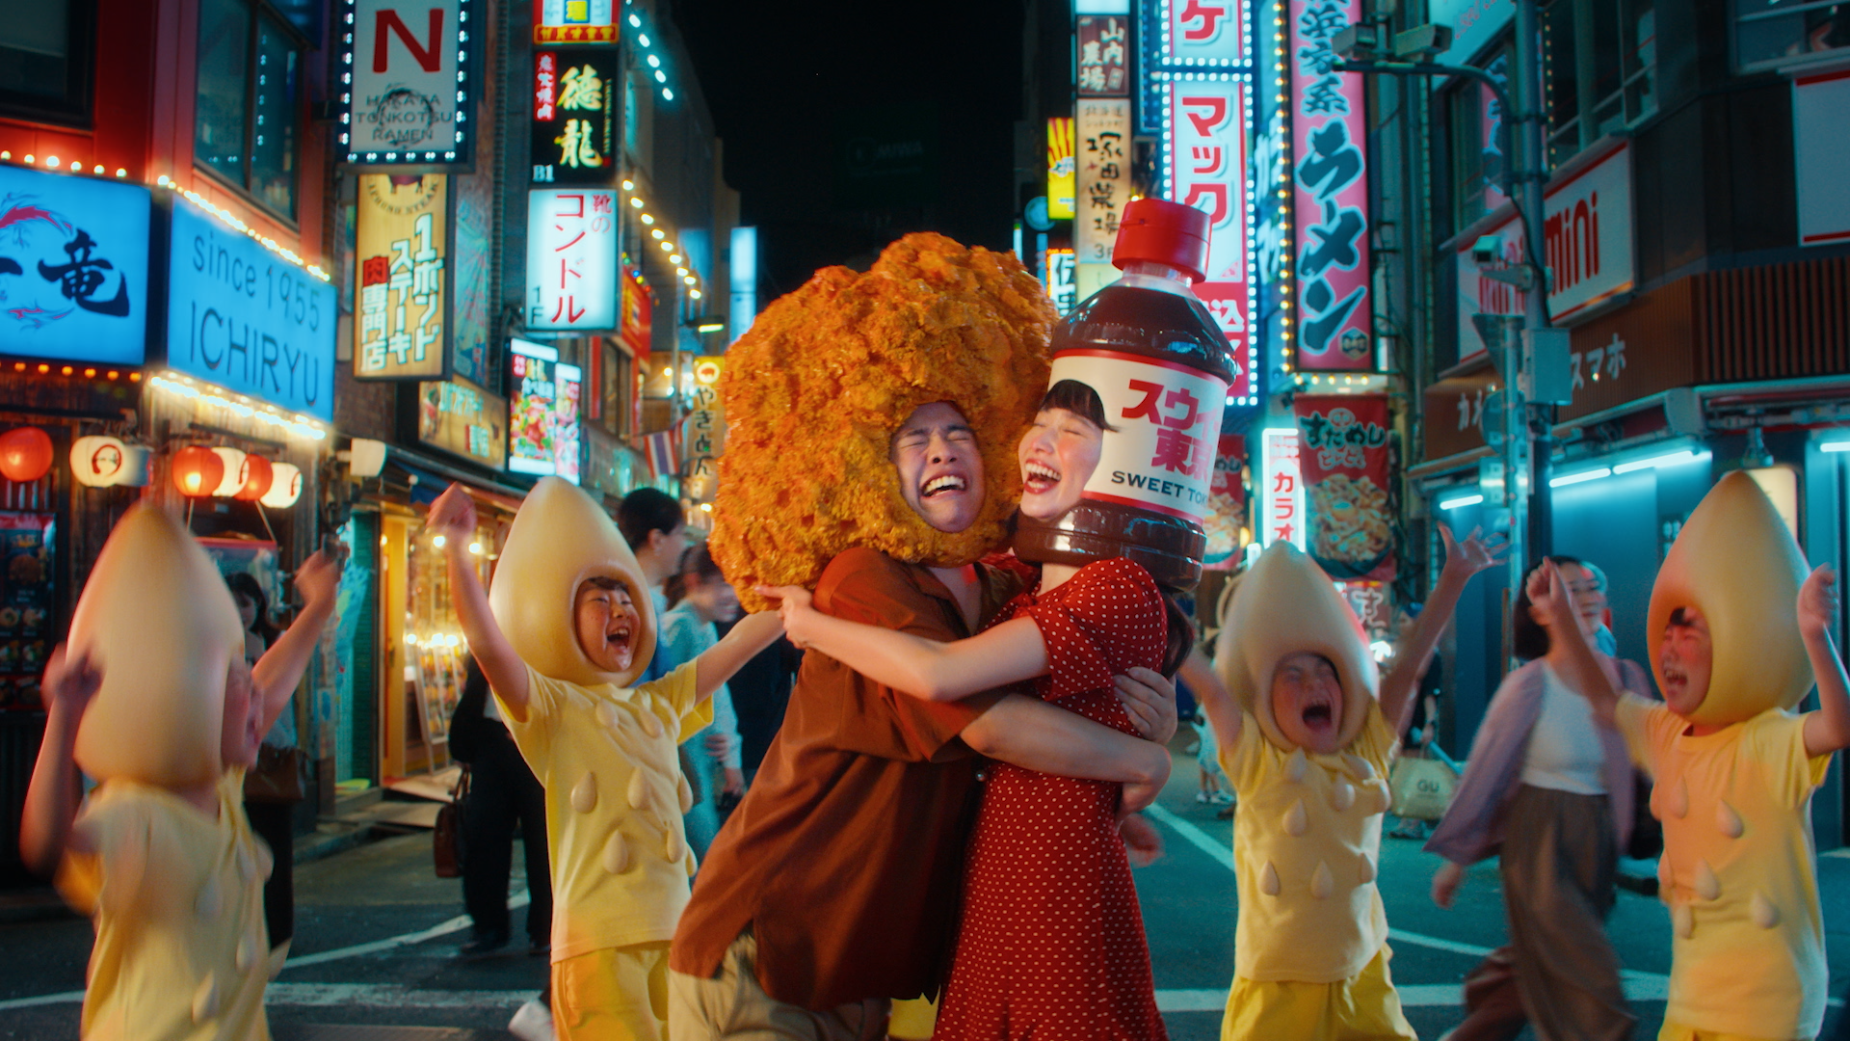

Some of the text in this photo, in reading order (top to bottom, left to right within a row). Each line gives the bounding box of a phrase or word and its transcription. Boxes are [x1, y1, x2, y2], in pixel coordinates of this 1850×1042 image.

[372, 8, 444, 73] N
[355, 111, 452, 123] TONKOTSU
[366, 93, 441, 107] HAKATA
[373, 129, 433, 140] RAMEN
[533, 164, 555, 182] B1
[592, 194, 612, 233] 靴の
[193, 231, 320, 332] since 1955
[413, 213, 445, 361] 1ポンド
[550, 194, 586, 324] コンドル
[360, 256, 389, 372] 肉専門店
[388, 239, 414, 364] ステーキ
[532, 286, 544, 325] 1F
[190, 301, 319, 407] ICHIRYU
[1151, 427, 1213, 483] 東京
[1110, 471, 1184, 498] SWEET
